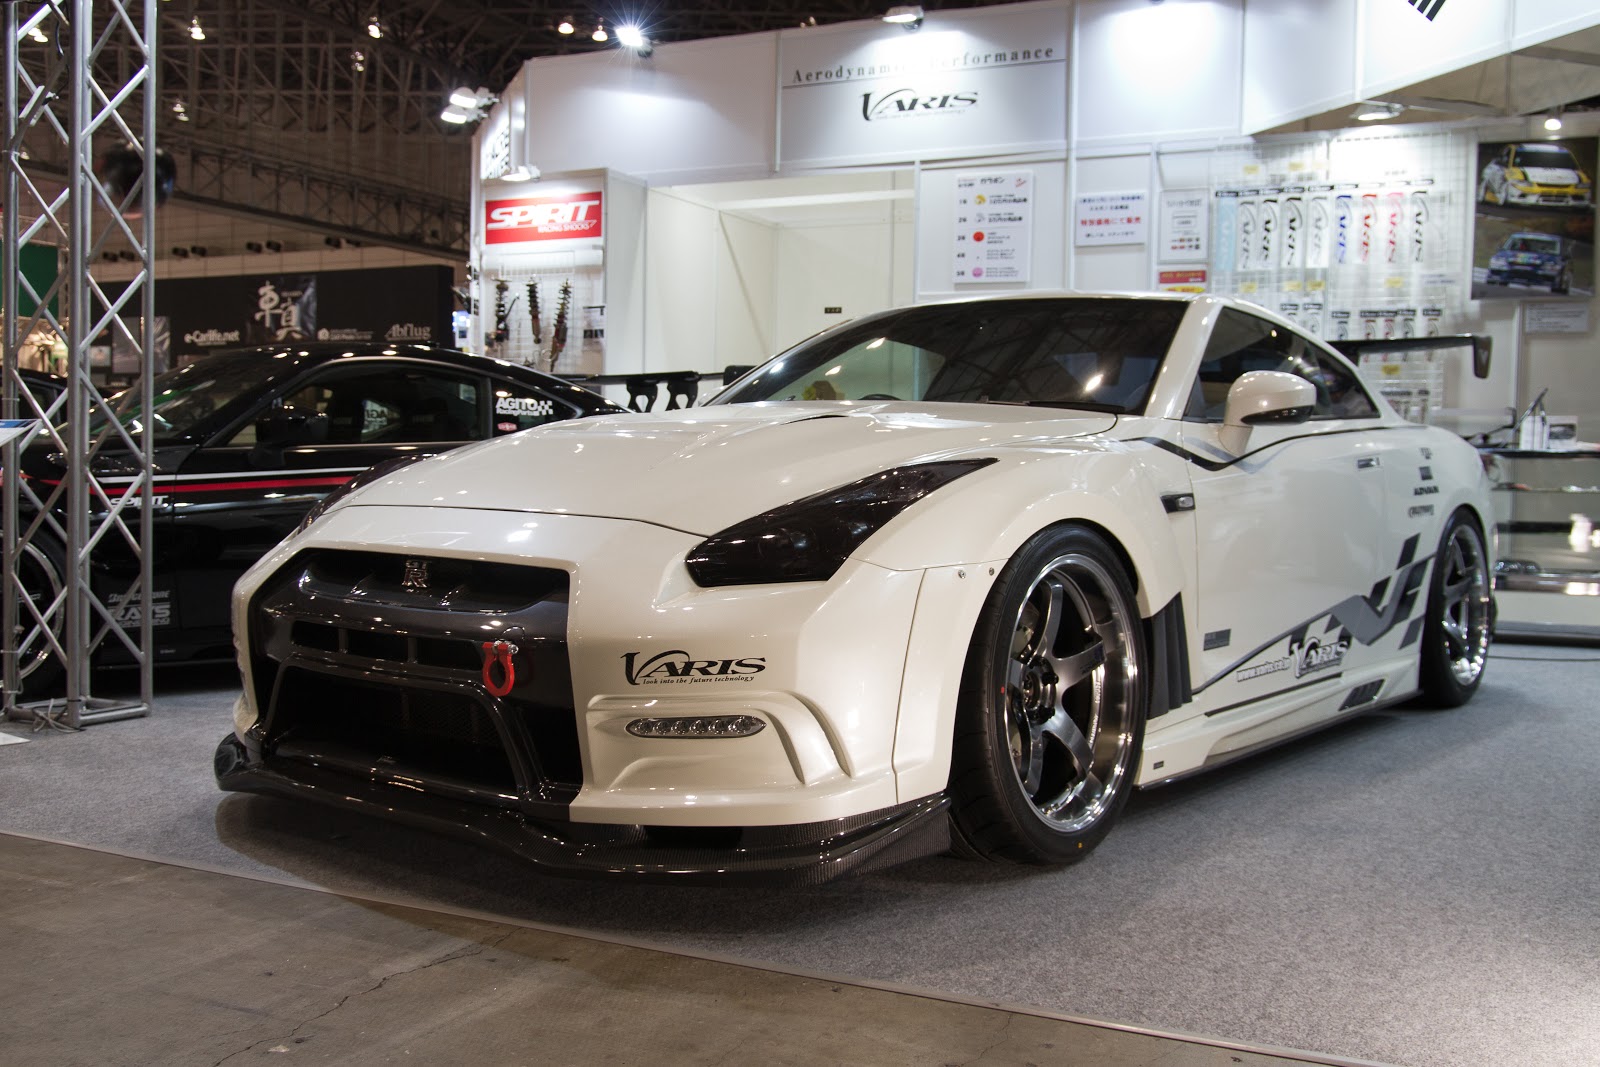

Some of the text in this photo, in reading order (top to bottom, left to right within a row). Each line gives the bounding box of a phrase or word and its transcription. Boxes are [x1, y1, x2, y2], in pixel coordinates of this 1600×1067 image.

[860, 88, 979, 121] VARIS
[487, 200, 600, 230] SPIRIT
[496, 397, 539, 410] AGITO
[620, 650, 766, 686] VARIS
[1292, 637, 1348, 678] VARIS
[688, 677, 713, 685] future
[714, 675, 755, 683] technology
